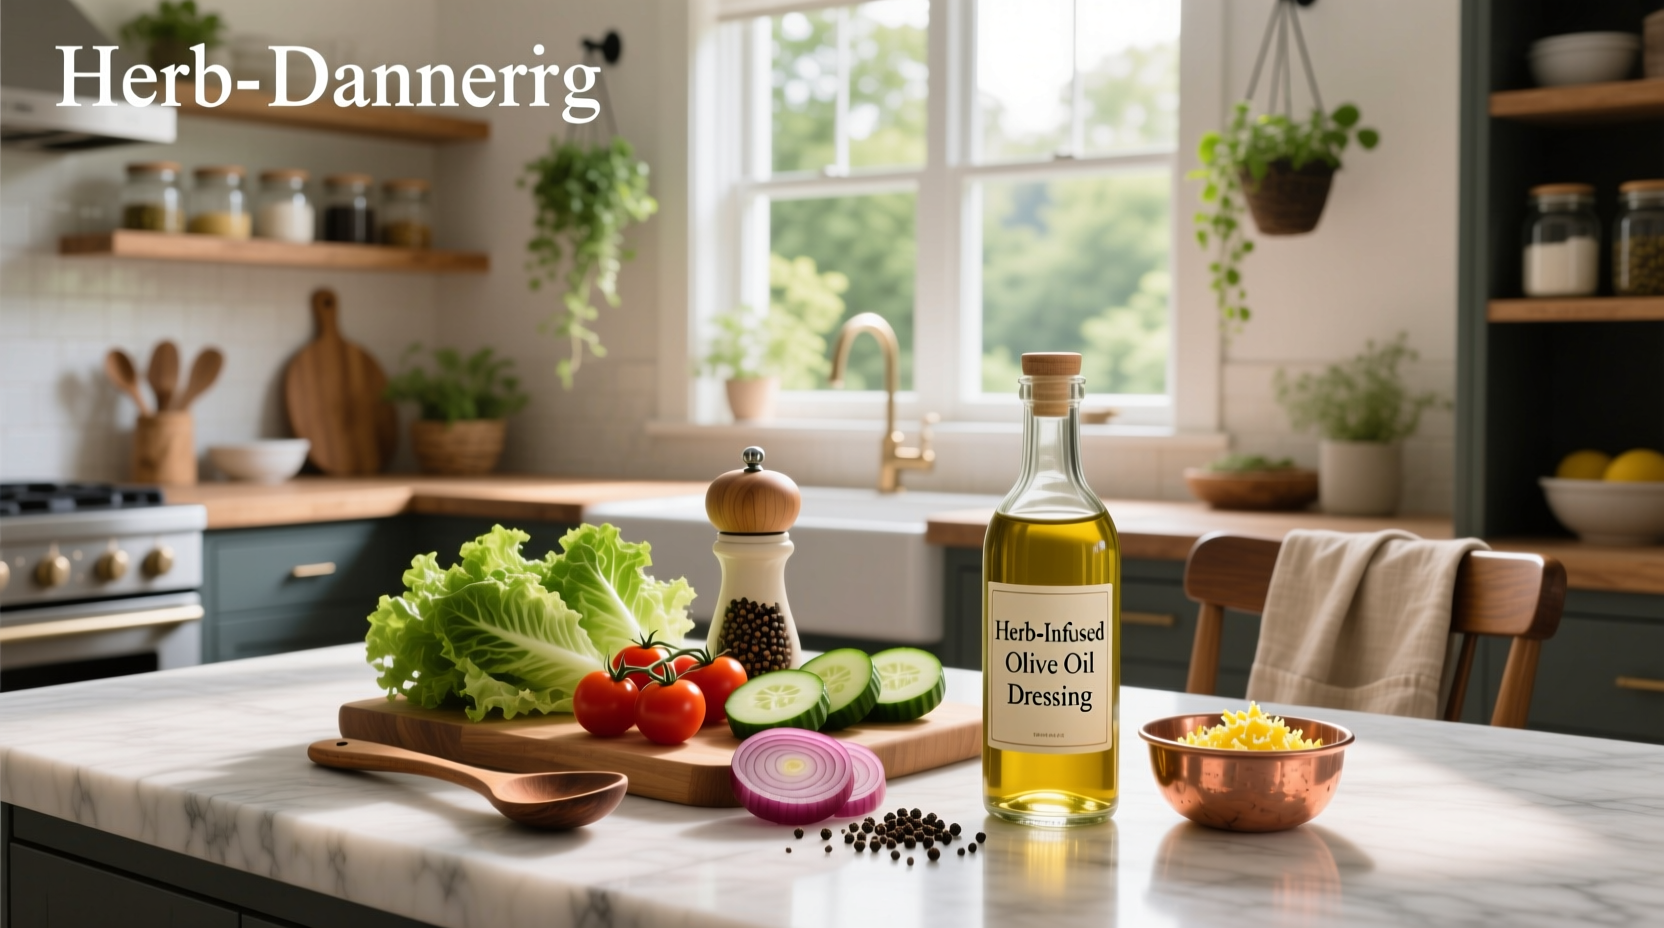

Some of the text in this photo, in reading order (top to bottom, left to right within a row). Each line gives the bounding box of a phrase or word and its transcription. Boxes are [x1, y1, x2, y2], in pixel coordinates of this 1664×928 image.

[995, 620, 1105, 642] Herb-Infused
[1005, 651, 1095, 674] Olive Oil
[1007, 683, 1093, 712] Dressing
